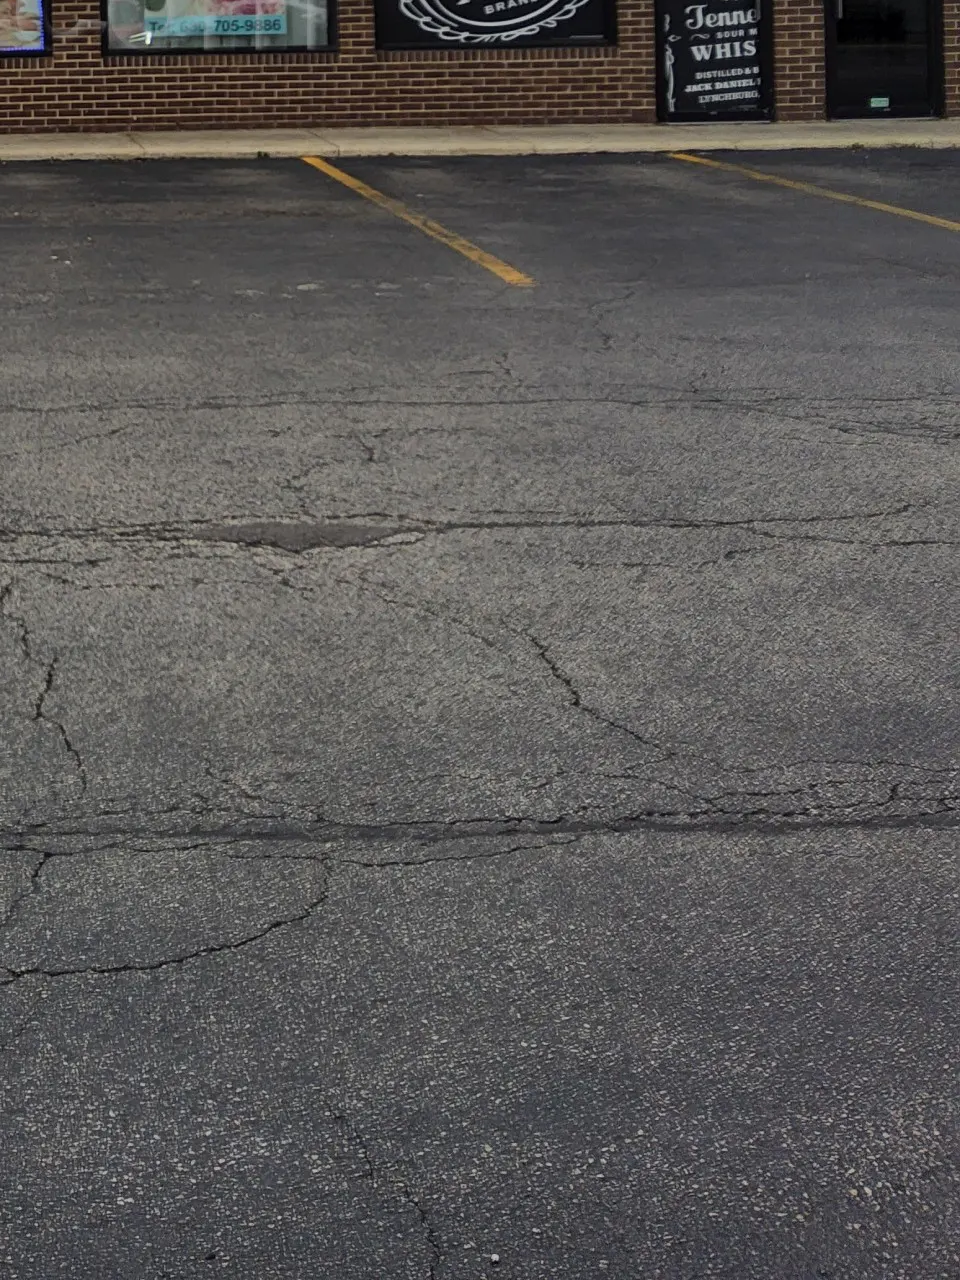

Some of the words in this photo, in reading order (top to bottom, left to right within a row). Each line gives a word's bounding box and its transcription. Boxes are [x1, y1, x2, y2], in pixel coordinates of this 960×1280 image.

[716, 29, 744, 39] SOUR
[690, 40, 757, 61] WHIS
[695, 67, 743, 80] DISTILLED
[684, 82, 712, 94] JACK
